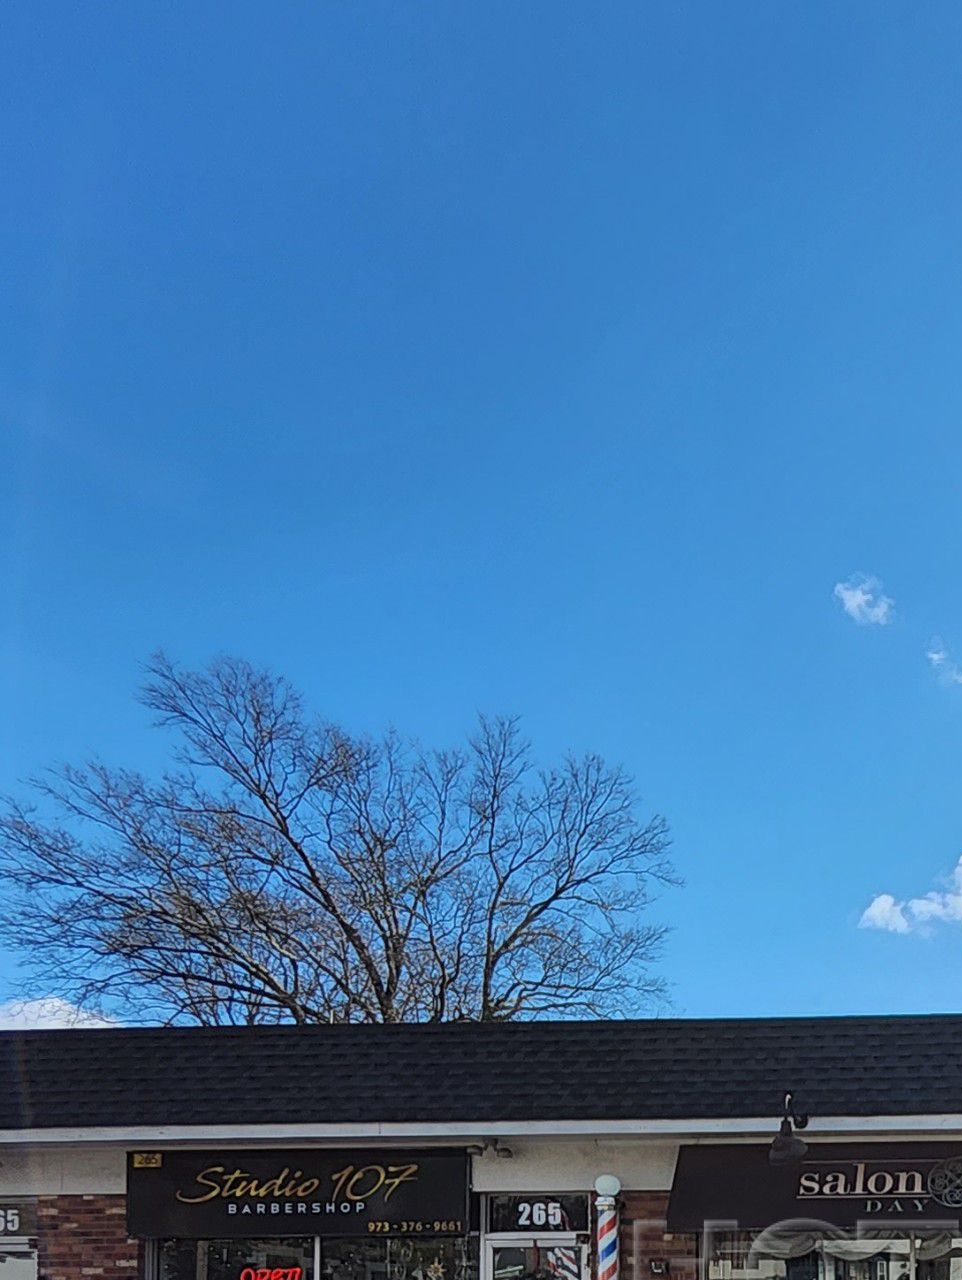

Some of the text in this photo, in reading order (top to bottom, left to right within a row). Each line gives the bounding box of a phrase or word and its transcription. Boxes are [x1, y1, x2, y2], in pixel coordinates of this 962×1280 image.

[137, 1153, 158, 1165] 265
[175, 1164, 418, 1204] Studio 107
[800, 1162, 927, 1195] salon
[227, 1202, 365, 1215] BARBERSHOP
[517, 1202, 561, 1226] 265
[865, 1199, 928, 1212] DAY
